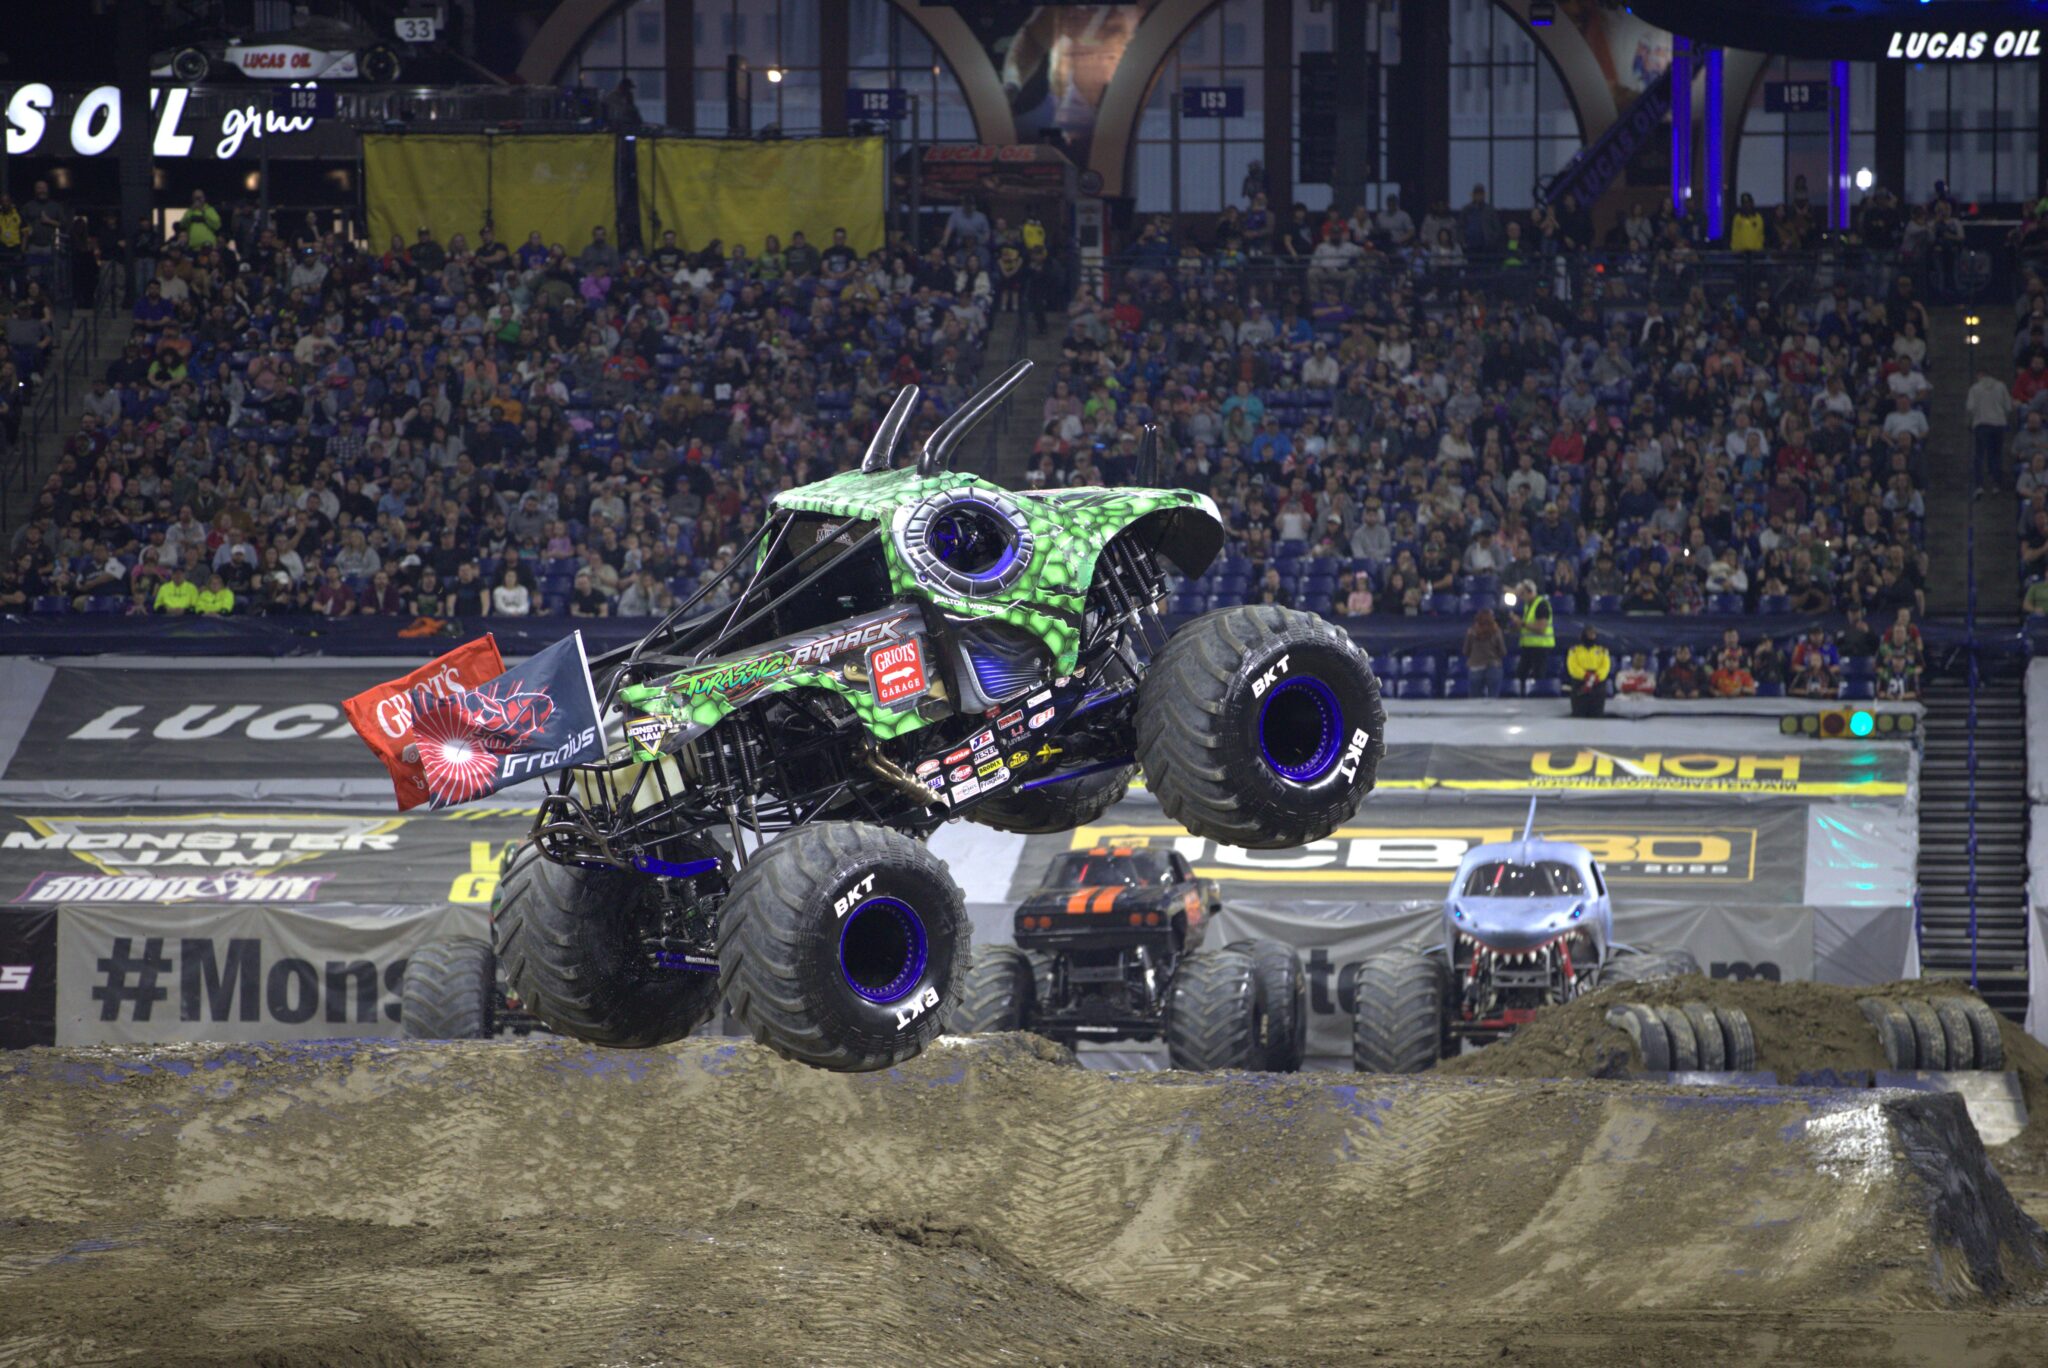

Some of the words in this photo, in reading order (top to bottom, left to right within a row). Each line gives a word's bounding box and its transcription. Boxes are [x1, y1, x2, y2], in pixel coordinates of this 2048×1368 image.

[405, 20, 430, 38] 33
[1887, 32, 1987, 59] LUCAS
[1994, 30, 2041, 56] OIL
[243, 53, 286, 68] LUCAS
[291, 53, 312, 68] OIL
[291, 91, 316, 108] 152
[863, 94, 889, 110] 152
[1201, 91, 1227, 107] 153
[1784, 86, 1809, 102] 153
[71, 86, 194, 156] OL
[925, 145, 995, 161] LUCAS
[789, 614, 908, 671] ATTACK
[1251, 654, 1290, 699] BKT
[881, 678, 921, 698] GARAGE
[639, 731, 661, 742] JAM
[502, 726, 596, 778] Fronius
[974, 745, 998, 760] JESEL
[1340, 728, 1370, 784] BKT
[979, 760, 1002, 773] BRODIX
[1531, 752, 1801, 780] UNOH
[2, 832, 399, 850] MONSTER
[103, 850, 283, 866] JAM
[833, 873, 876, 919] BKT
[896, 986, 940, 1031] BKT
